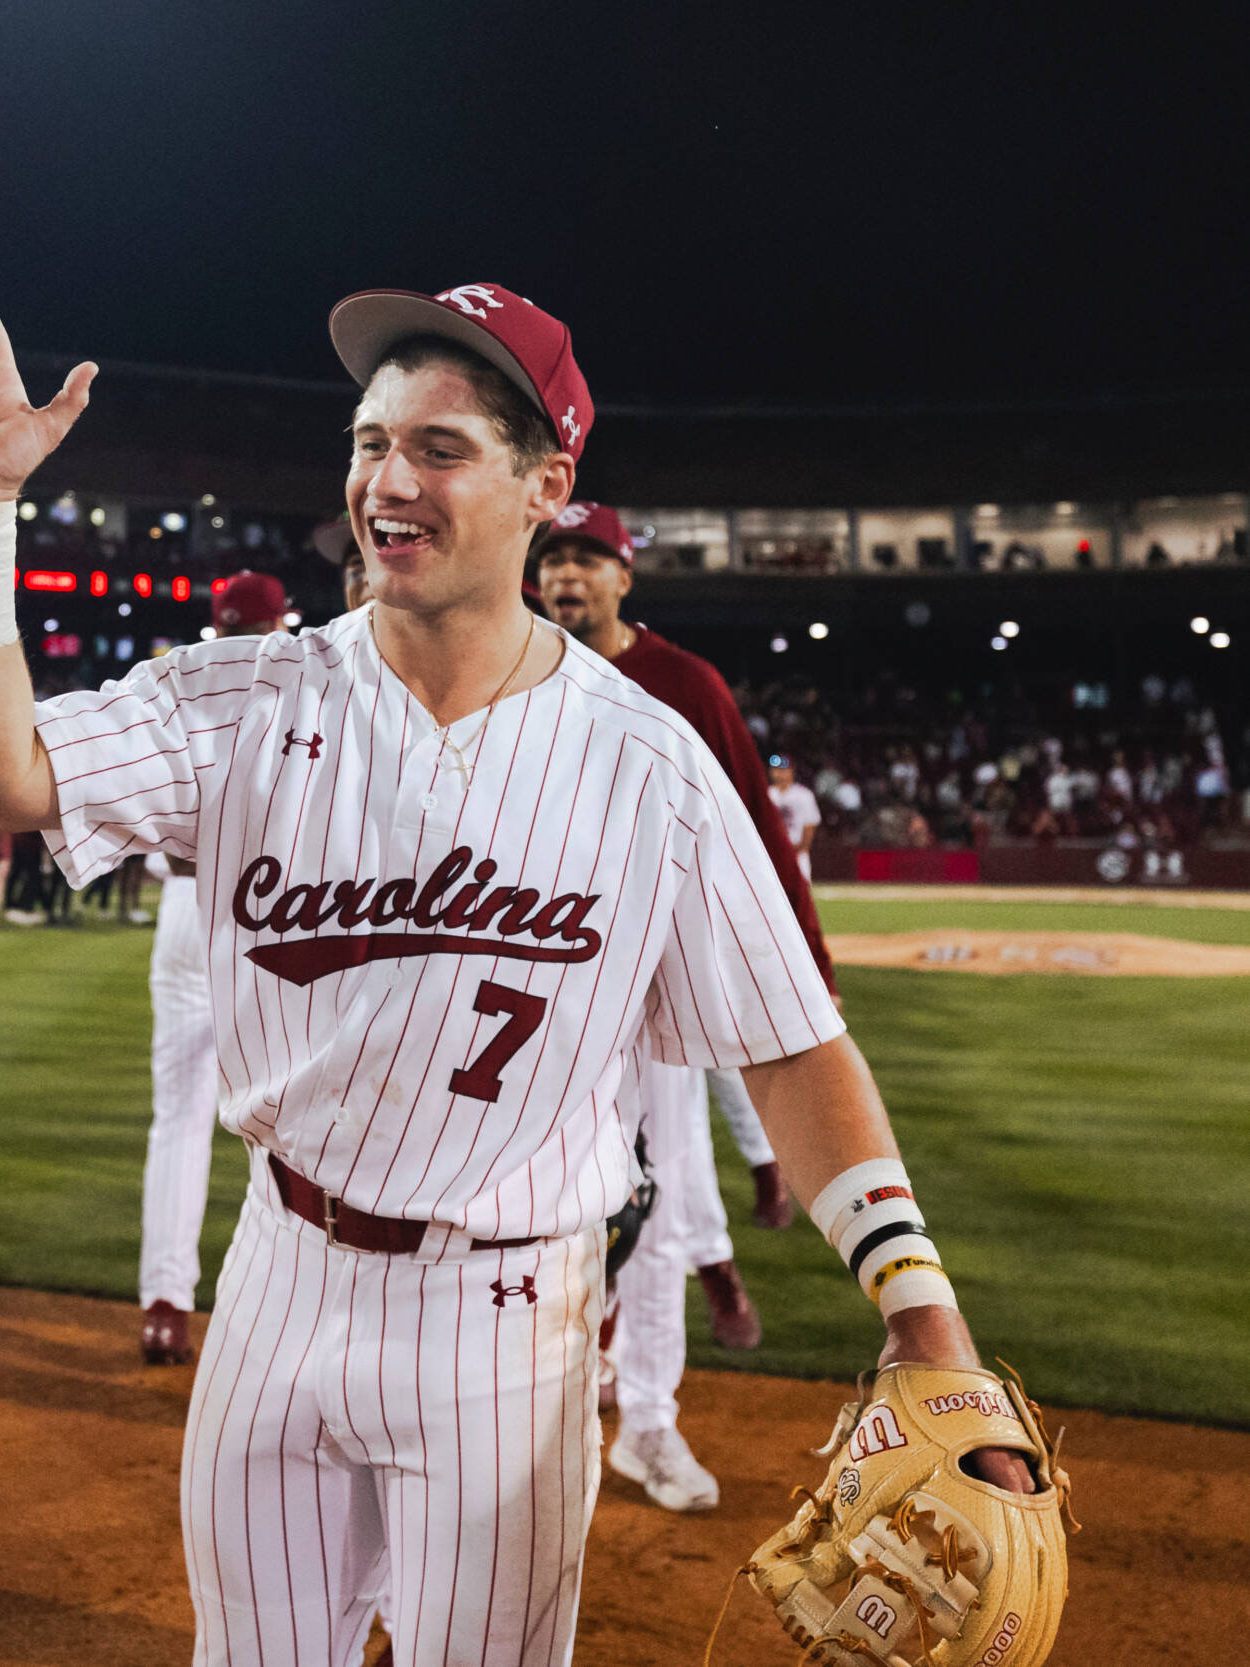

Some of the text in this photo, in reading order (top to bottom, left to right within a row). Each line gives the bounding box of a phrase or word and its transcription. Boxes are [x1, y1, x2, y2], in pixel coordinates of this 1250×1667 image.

[232, 846, 603, 944] Carolina
[448, 979, 549, 1104] 7
[973, 1611, 1023, 1667] 000
